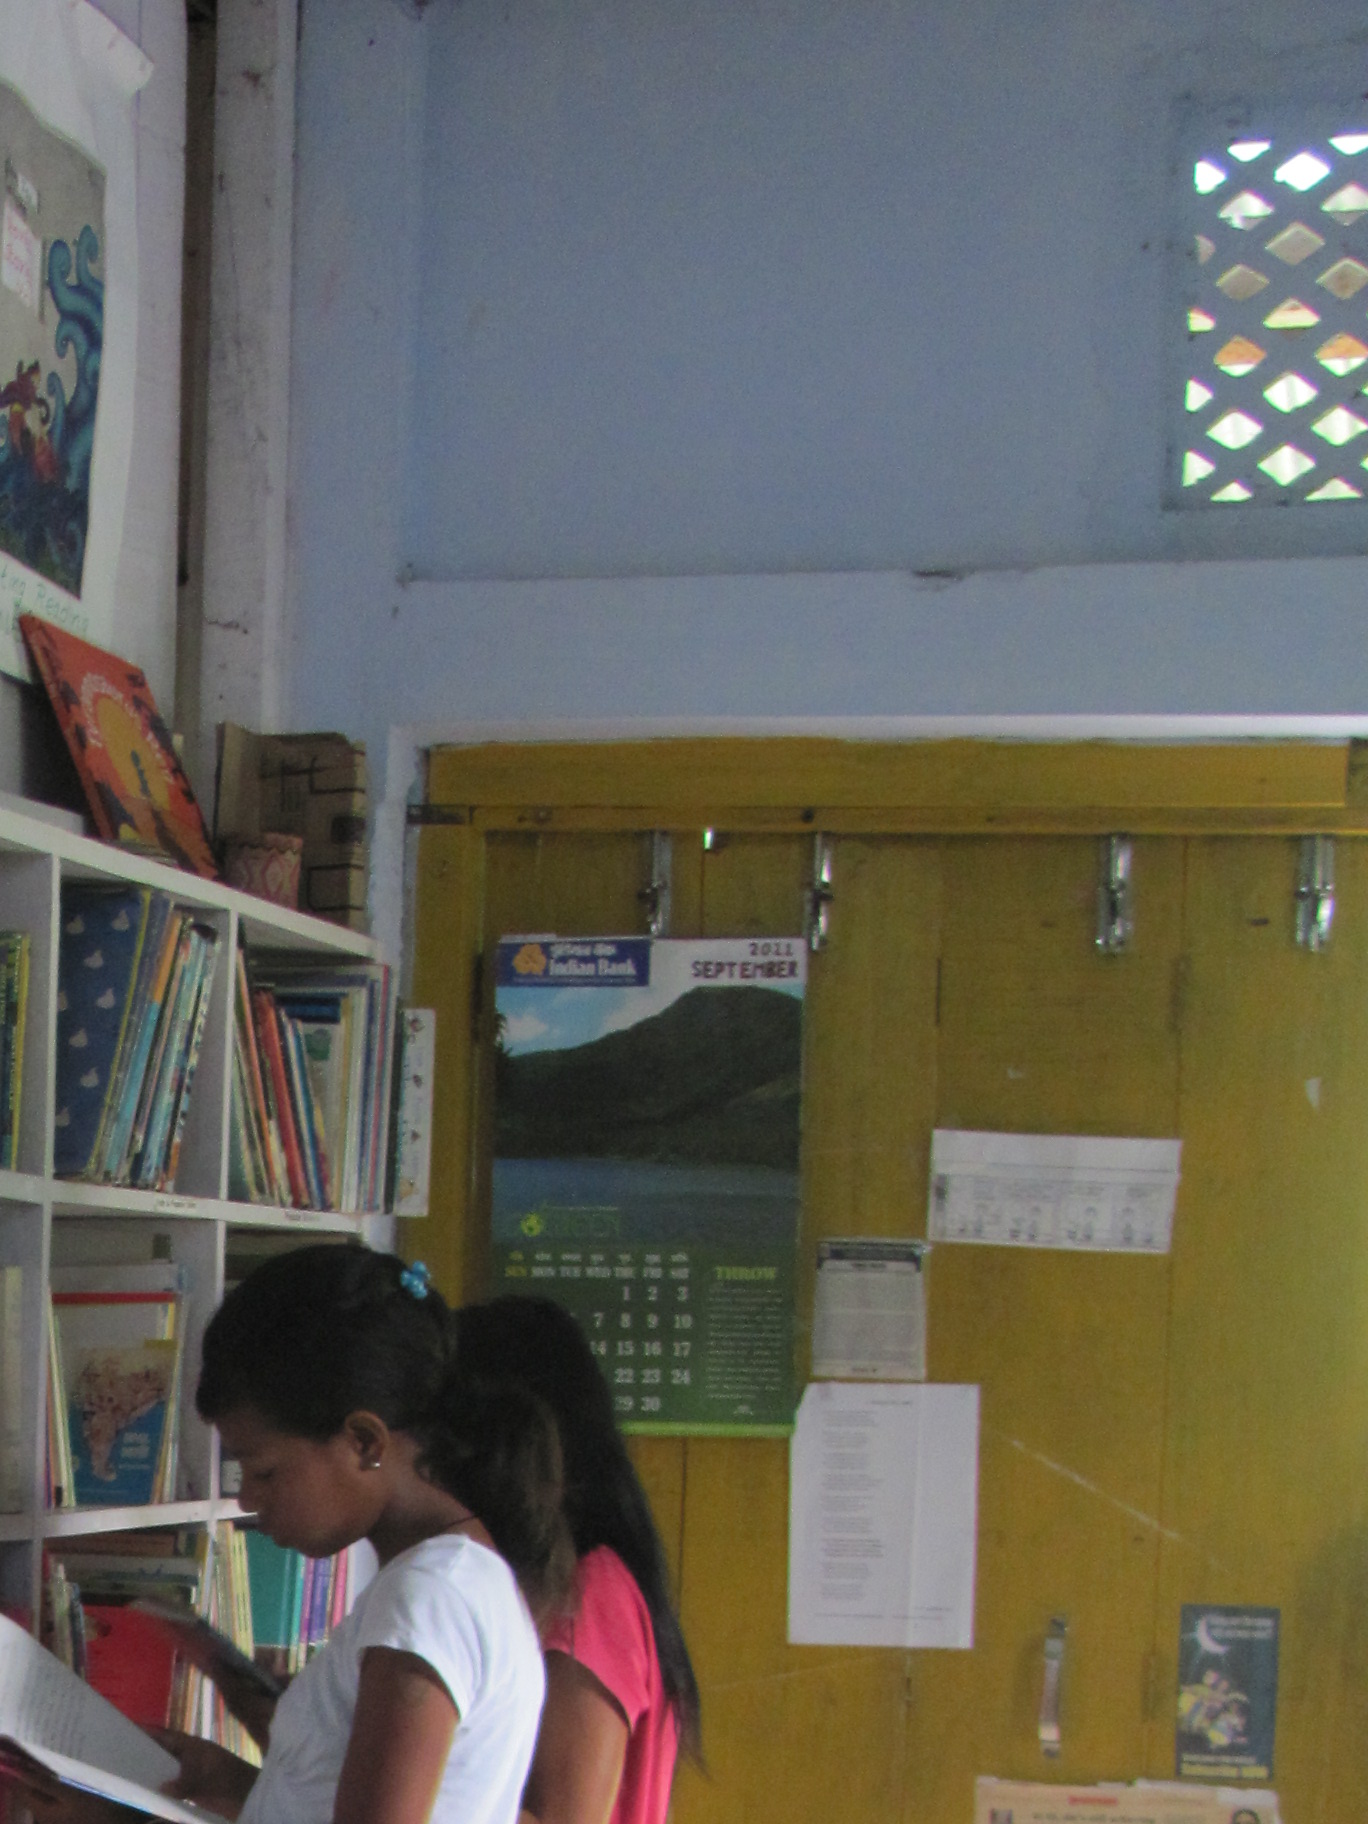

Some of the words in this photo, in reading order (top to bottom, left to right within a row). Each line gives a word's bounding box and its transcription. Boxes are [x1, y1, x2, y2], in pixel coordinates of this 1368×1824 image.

[749, 942, 794, 957] 2011
[549, 958, 594, 977] Indian
[598, 960, 637, 977] Bank
[691, 959, 799, 979] SEPTEMBER
[648, 1286, 658, 1301] 2
[674, 1313, 692, 1329] 10
[673, 1342, 691, 1357] 17
[641, 1368, 661, 1384] 23
[672, 1368, 691, 1384] 24
[641, 1396, 661, 1412] 30
